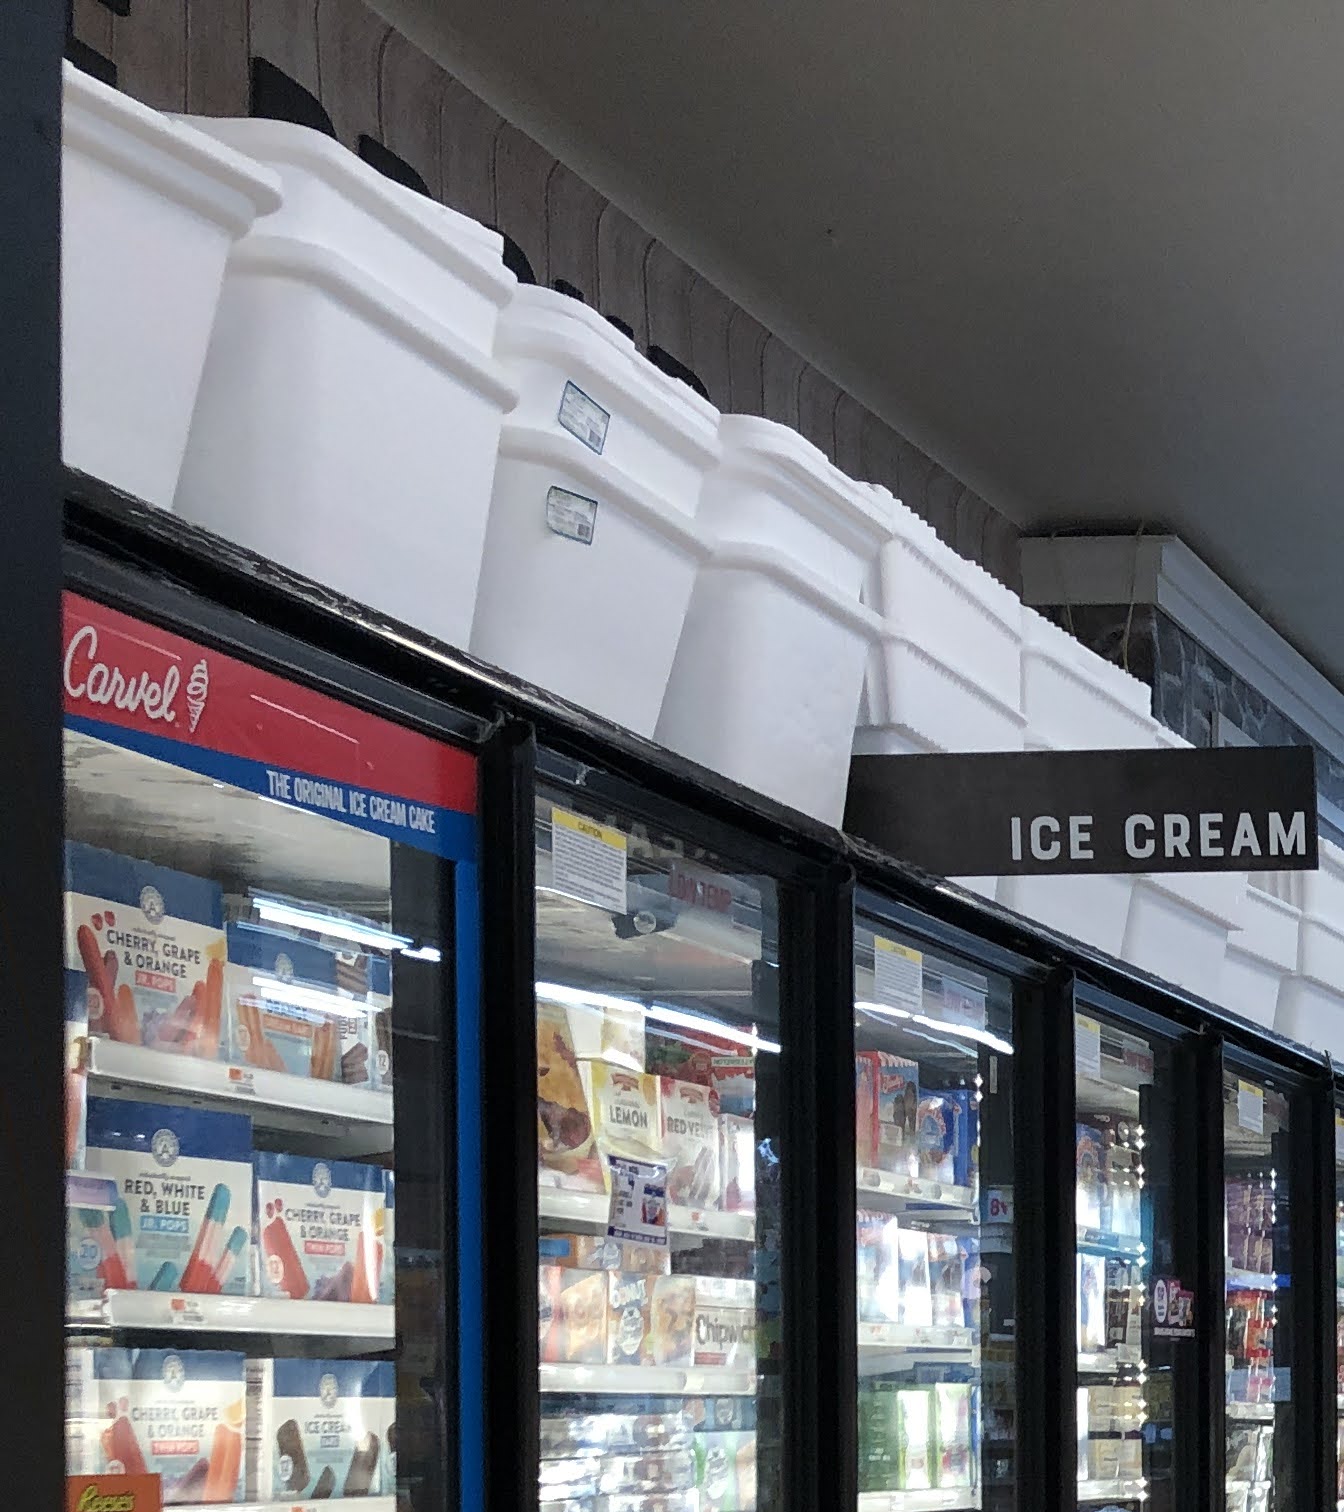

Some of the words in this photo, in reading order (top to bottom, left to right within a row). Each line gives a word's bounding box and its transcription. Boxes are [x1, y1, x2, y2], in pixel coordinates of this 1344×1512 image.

[63, 625, 181, 722] Carvel
[266, 770, 290, 797] THE
[293, 776, 345, 812] ORIGINAL
[349, 789, 367, 816] ICE
[369, 794, 408, 828] CREAM
[408, 804, 437, 834] CAKE
[1011, 814, 1094, 862] ICE
[1125, 810, 1308, 858] CREAM
[106, 929, 158, 957] CHERRY,
[162, 942, 202, 966] GRAPE
[124, 950, 134, 967] &
[137, 955, 188, 979] ORANGE
[609, 1104, 648, 1129] LEMON
[124, 1179, 158, 1199] RED,
[162, 1182, 207, 1201] WHITE
[140, 1199, 150, 1214] &
[154, 1200, 191, 1217] BLUE
